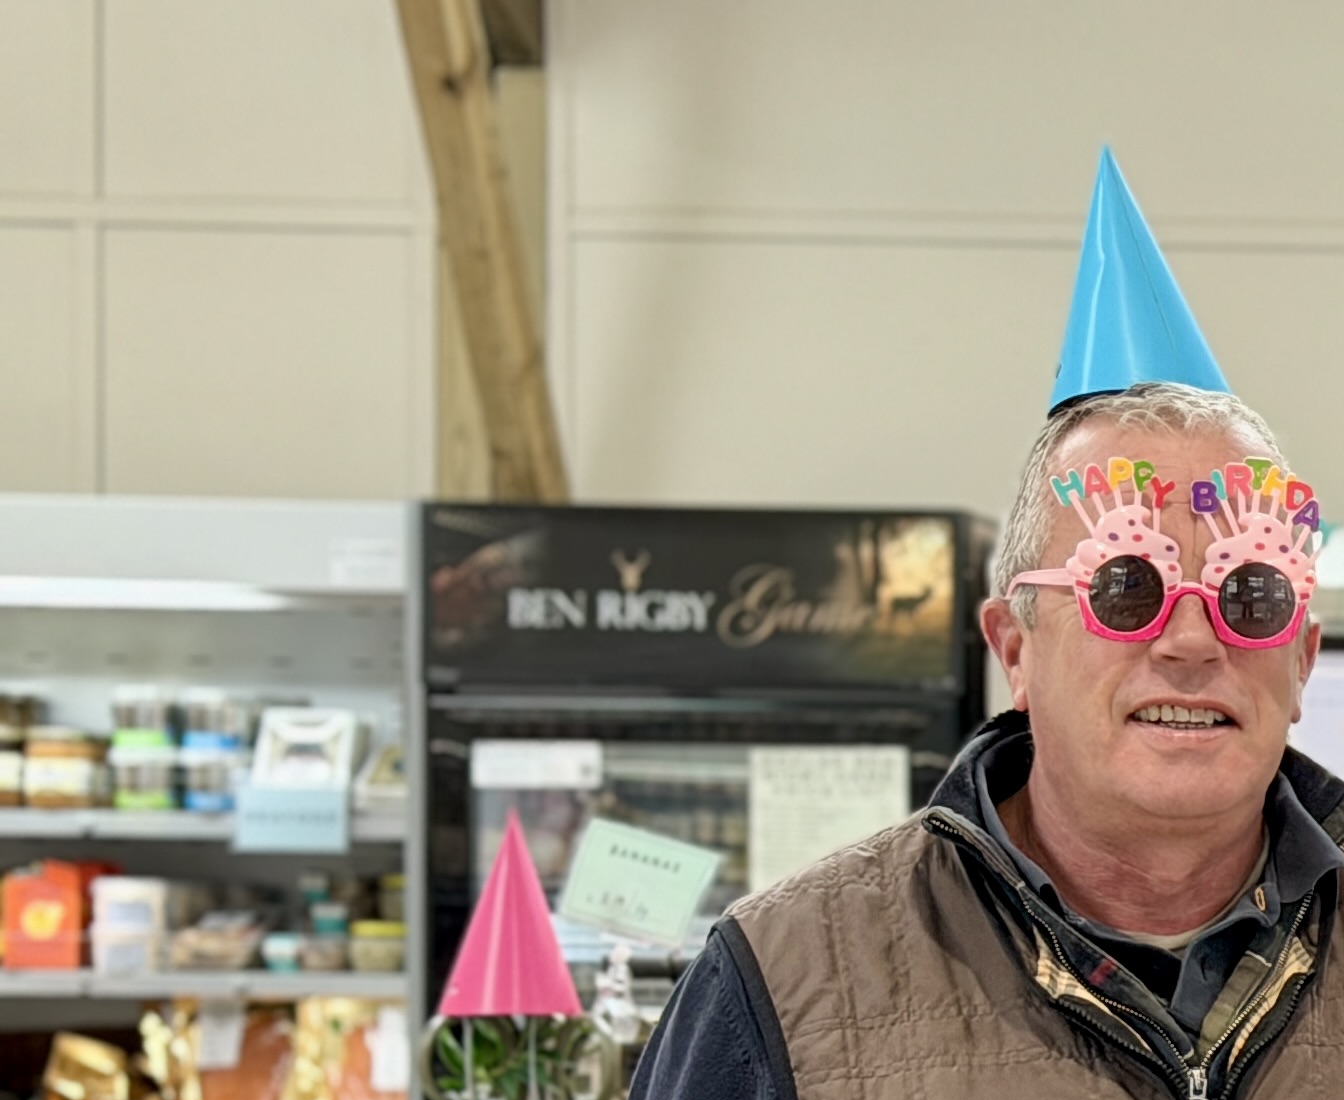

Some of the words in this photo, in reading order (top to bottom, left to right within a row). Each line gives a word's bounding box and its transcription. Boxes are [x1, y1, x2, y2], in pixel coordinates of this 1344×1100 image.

[1050, 456, 1176, 507] HAPPY
[507, 586, 587, 630] BEN
[595, 587, 716, 633] RIGBY
